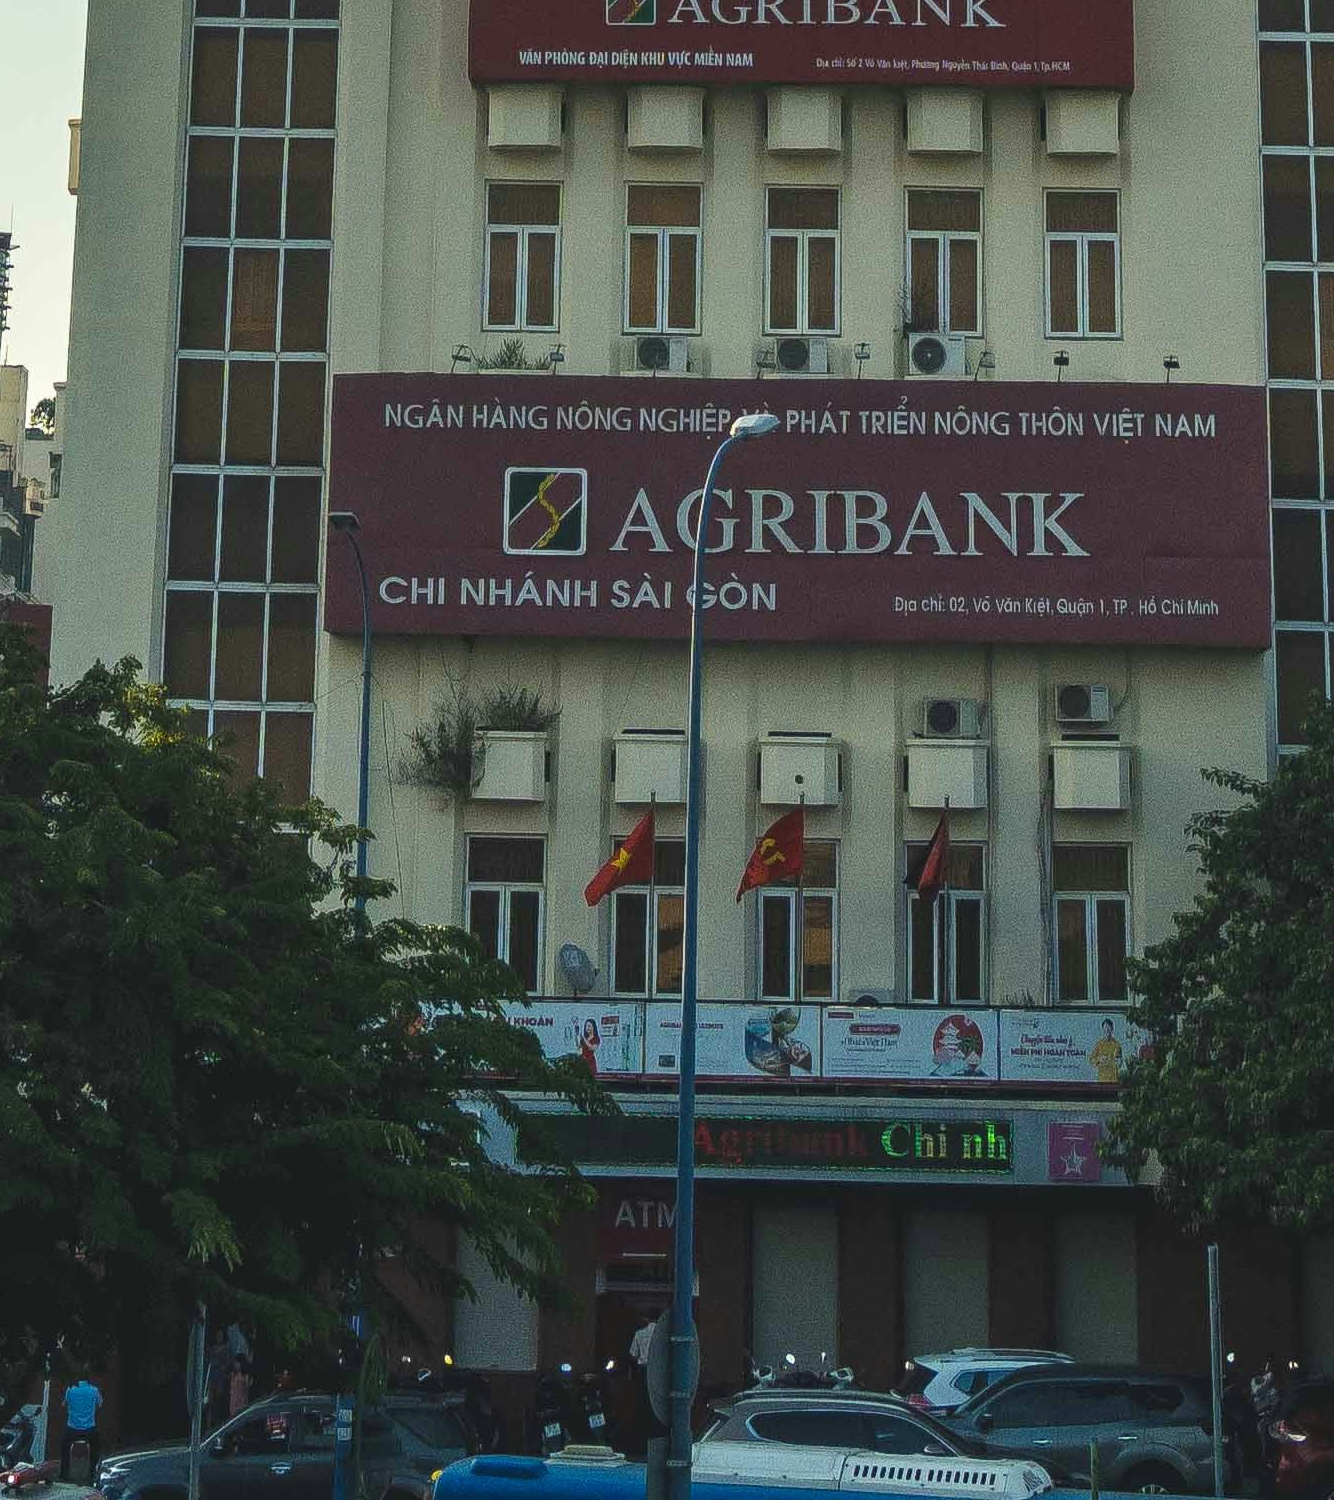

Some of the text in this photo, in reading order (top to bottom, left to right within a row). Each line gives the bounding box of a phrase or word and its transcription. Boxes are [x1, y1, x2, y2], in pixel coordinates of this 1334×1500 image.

[519, 46, 754, 68] VĂN PHÒNG ĐẠI DIỆN KHU VỰC MIỀN NAM
[385, 399, 463, 428] NGÂN
[472, 398, 548, 430] HÀNG
[556, 400, 631, 432] NÔNG
[640, 402, 731, 440] NGHIỆP
[786, 402, 850, 435] PHÁT
[859, 395, 926, 436] TRIỂN
[934, 405, 1010, 437] NÔNG
[1019, 406, 1083, 437] THÔN
[1093, 407, 1145, 444] VIỆT
[1155, 413, 1216, 438] NAM
[608, 486, 1091, 556] AGRIBANK
[379, 571, 777, 611] CHI NHÁNH SÀI GÒN
[895, 595, 919, 616] Địa
[921, 593, 945, 612] chỉ:
[949, 596, 969, 615] 02,
[973, 595, 991, 612] Võ
[995, 596, 1021, 612] Văn
[1025, 597, 1054, 616] Kiệt,
[1057, 598, 1094, 617] Quận
[1100, 599, 1110, 616] 1,
[1140, 598, 1157, 614] Hồ
[1162, 600, 1184, 614] Chí
[1187, 600, 1219, 616] Minh
[880, 1122, 948, 1160] Chi
[963, 1121, 1008, 1161] nh
[614, 1200, 678, 1229] ATM
